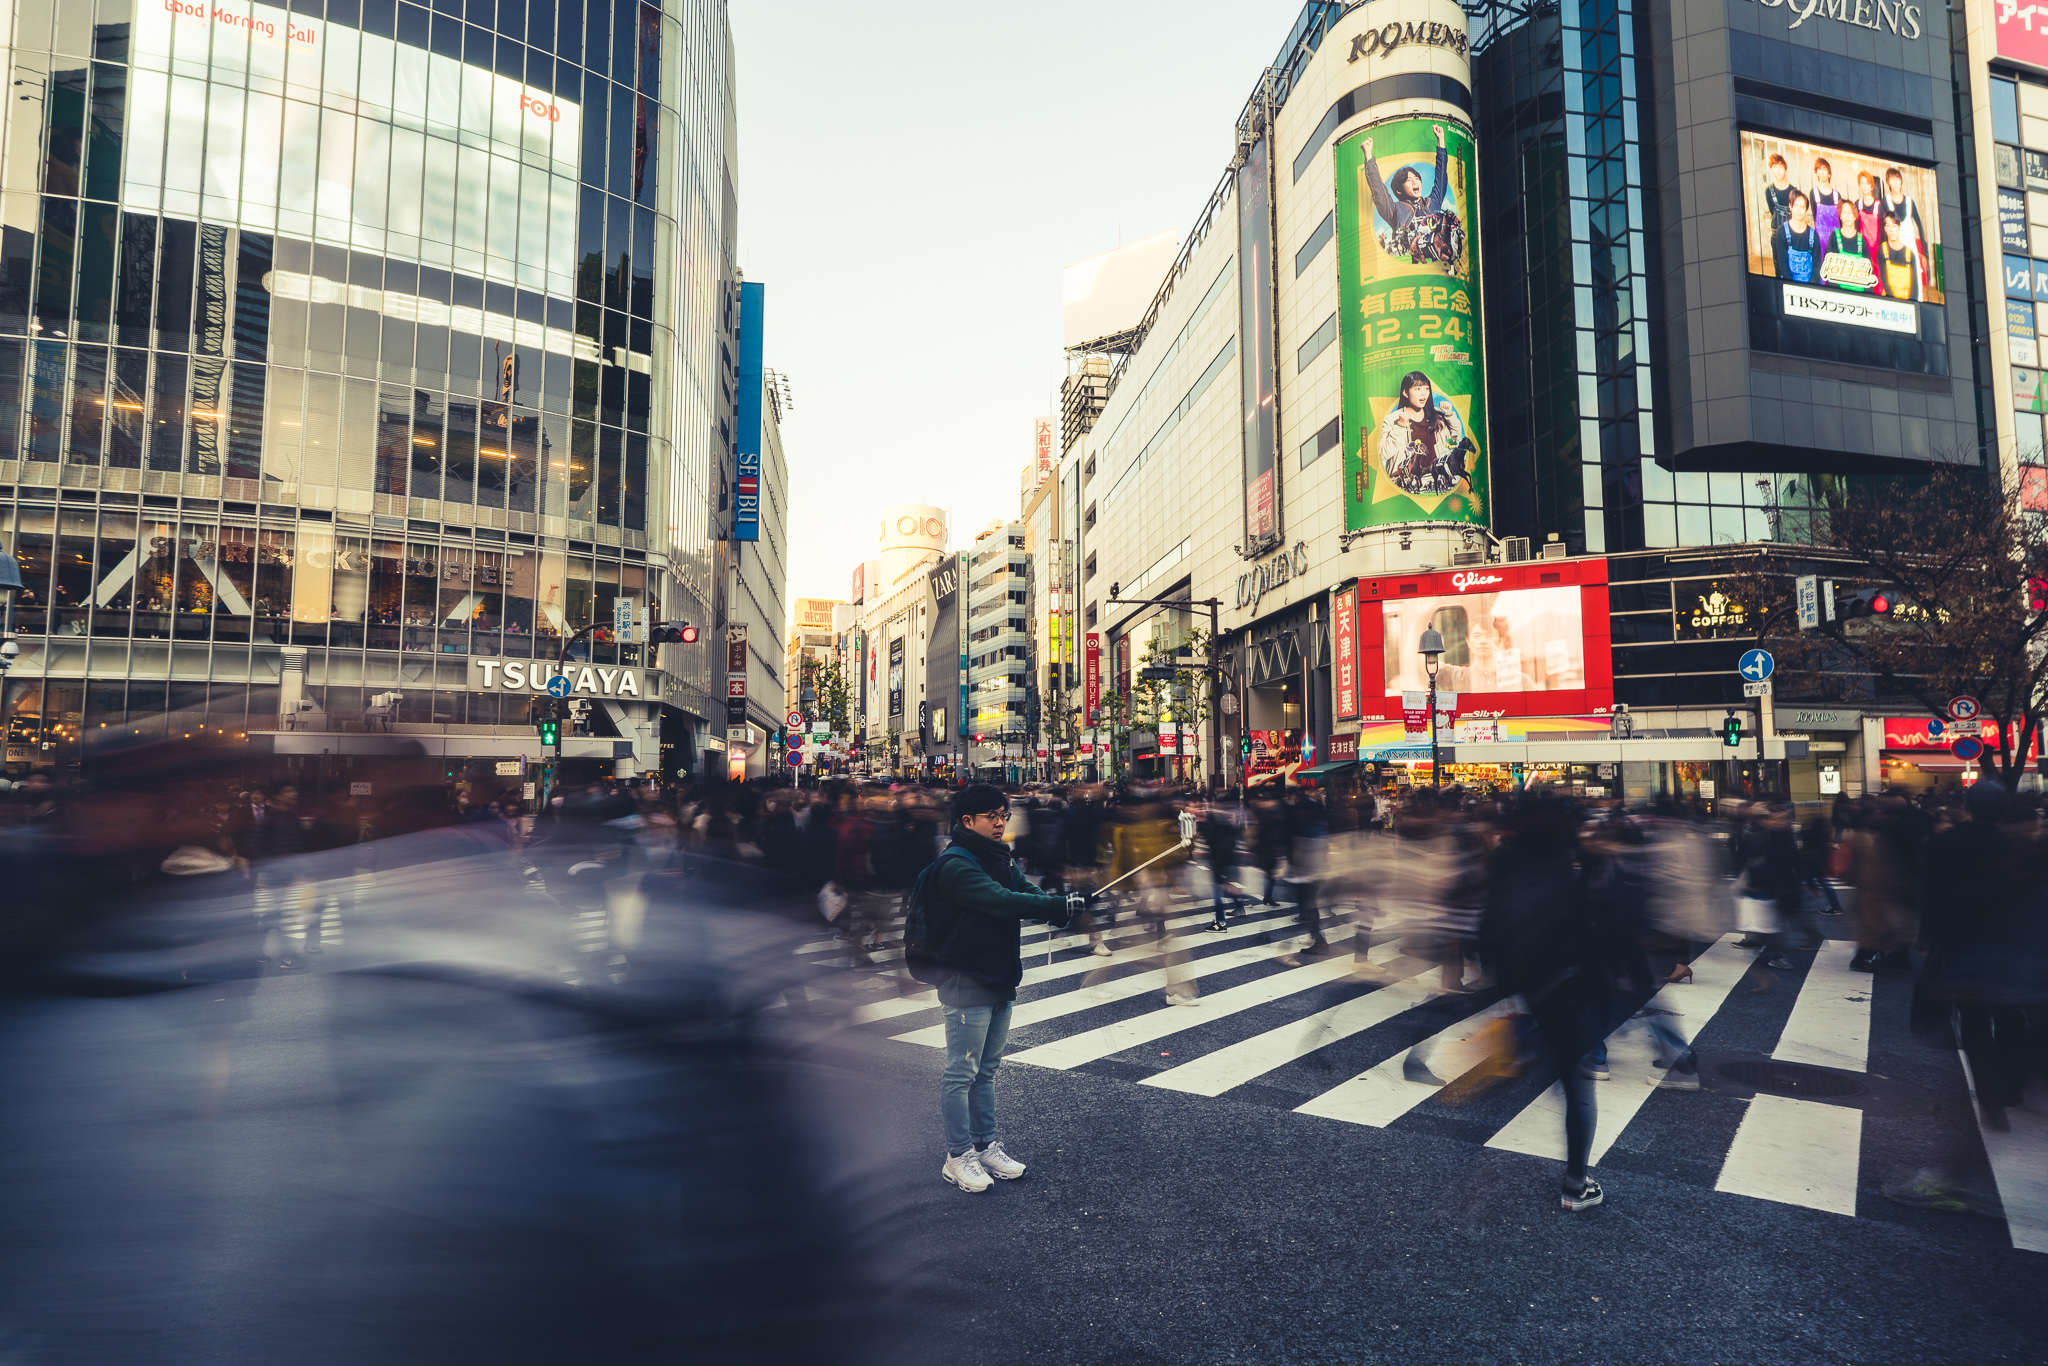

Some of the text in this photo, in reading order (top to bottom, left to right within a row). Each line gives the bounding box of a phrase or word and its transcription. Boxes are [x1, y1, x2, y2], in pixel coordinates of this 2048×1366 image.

[164, 0, 205, 18] Good
[210, 5, 274, 38] Morning
[287, 23, 315, 45] Call
[1747, 0, 1921, 40] 9MEN'S
[520, 94, 560, 122] FOD
[1360, 286, 1473, 319] 有馬記念
[1361, 314, 1465, 348] 12.24
[1038, 421, 1051, 473] 大和証券
[396, 554, 515, 587] COFFEE
[932, 566, 957, 600] ZARA
[1452, 571, 1503, 592] Glico
[1804, 580, 1816, 624] 渋谷駅前
[622, 601, 631, 639] 渋谷駅前
[1691, 614, 1744, 627] COFFEE
[477, 659, 639, 697] TSUTAYA
[1339, 611, 1353, 714] 天津甘栗
[731, 682, 743, 694] 本
[1089, 659, 1097, 718] 三菱東京UFJ
[8, 749, 26, 757] ONE
[1330, 740, 1355, 755] 天津甘栗
[1446, 764, 1473, 773] TAX
[1474, 764, 1498, 773] Free
